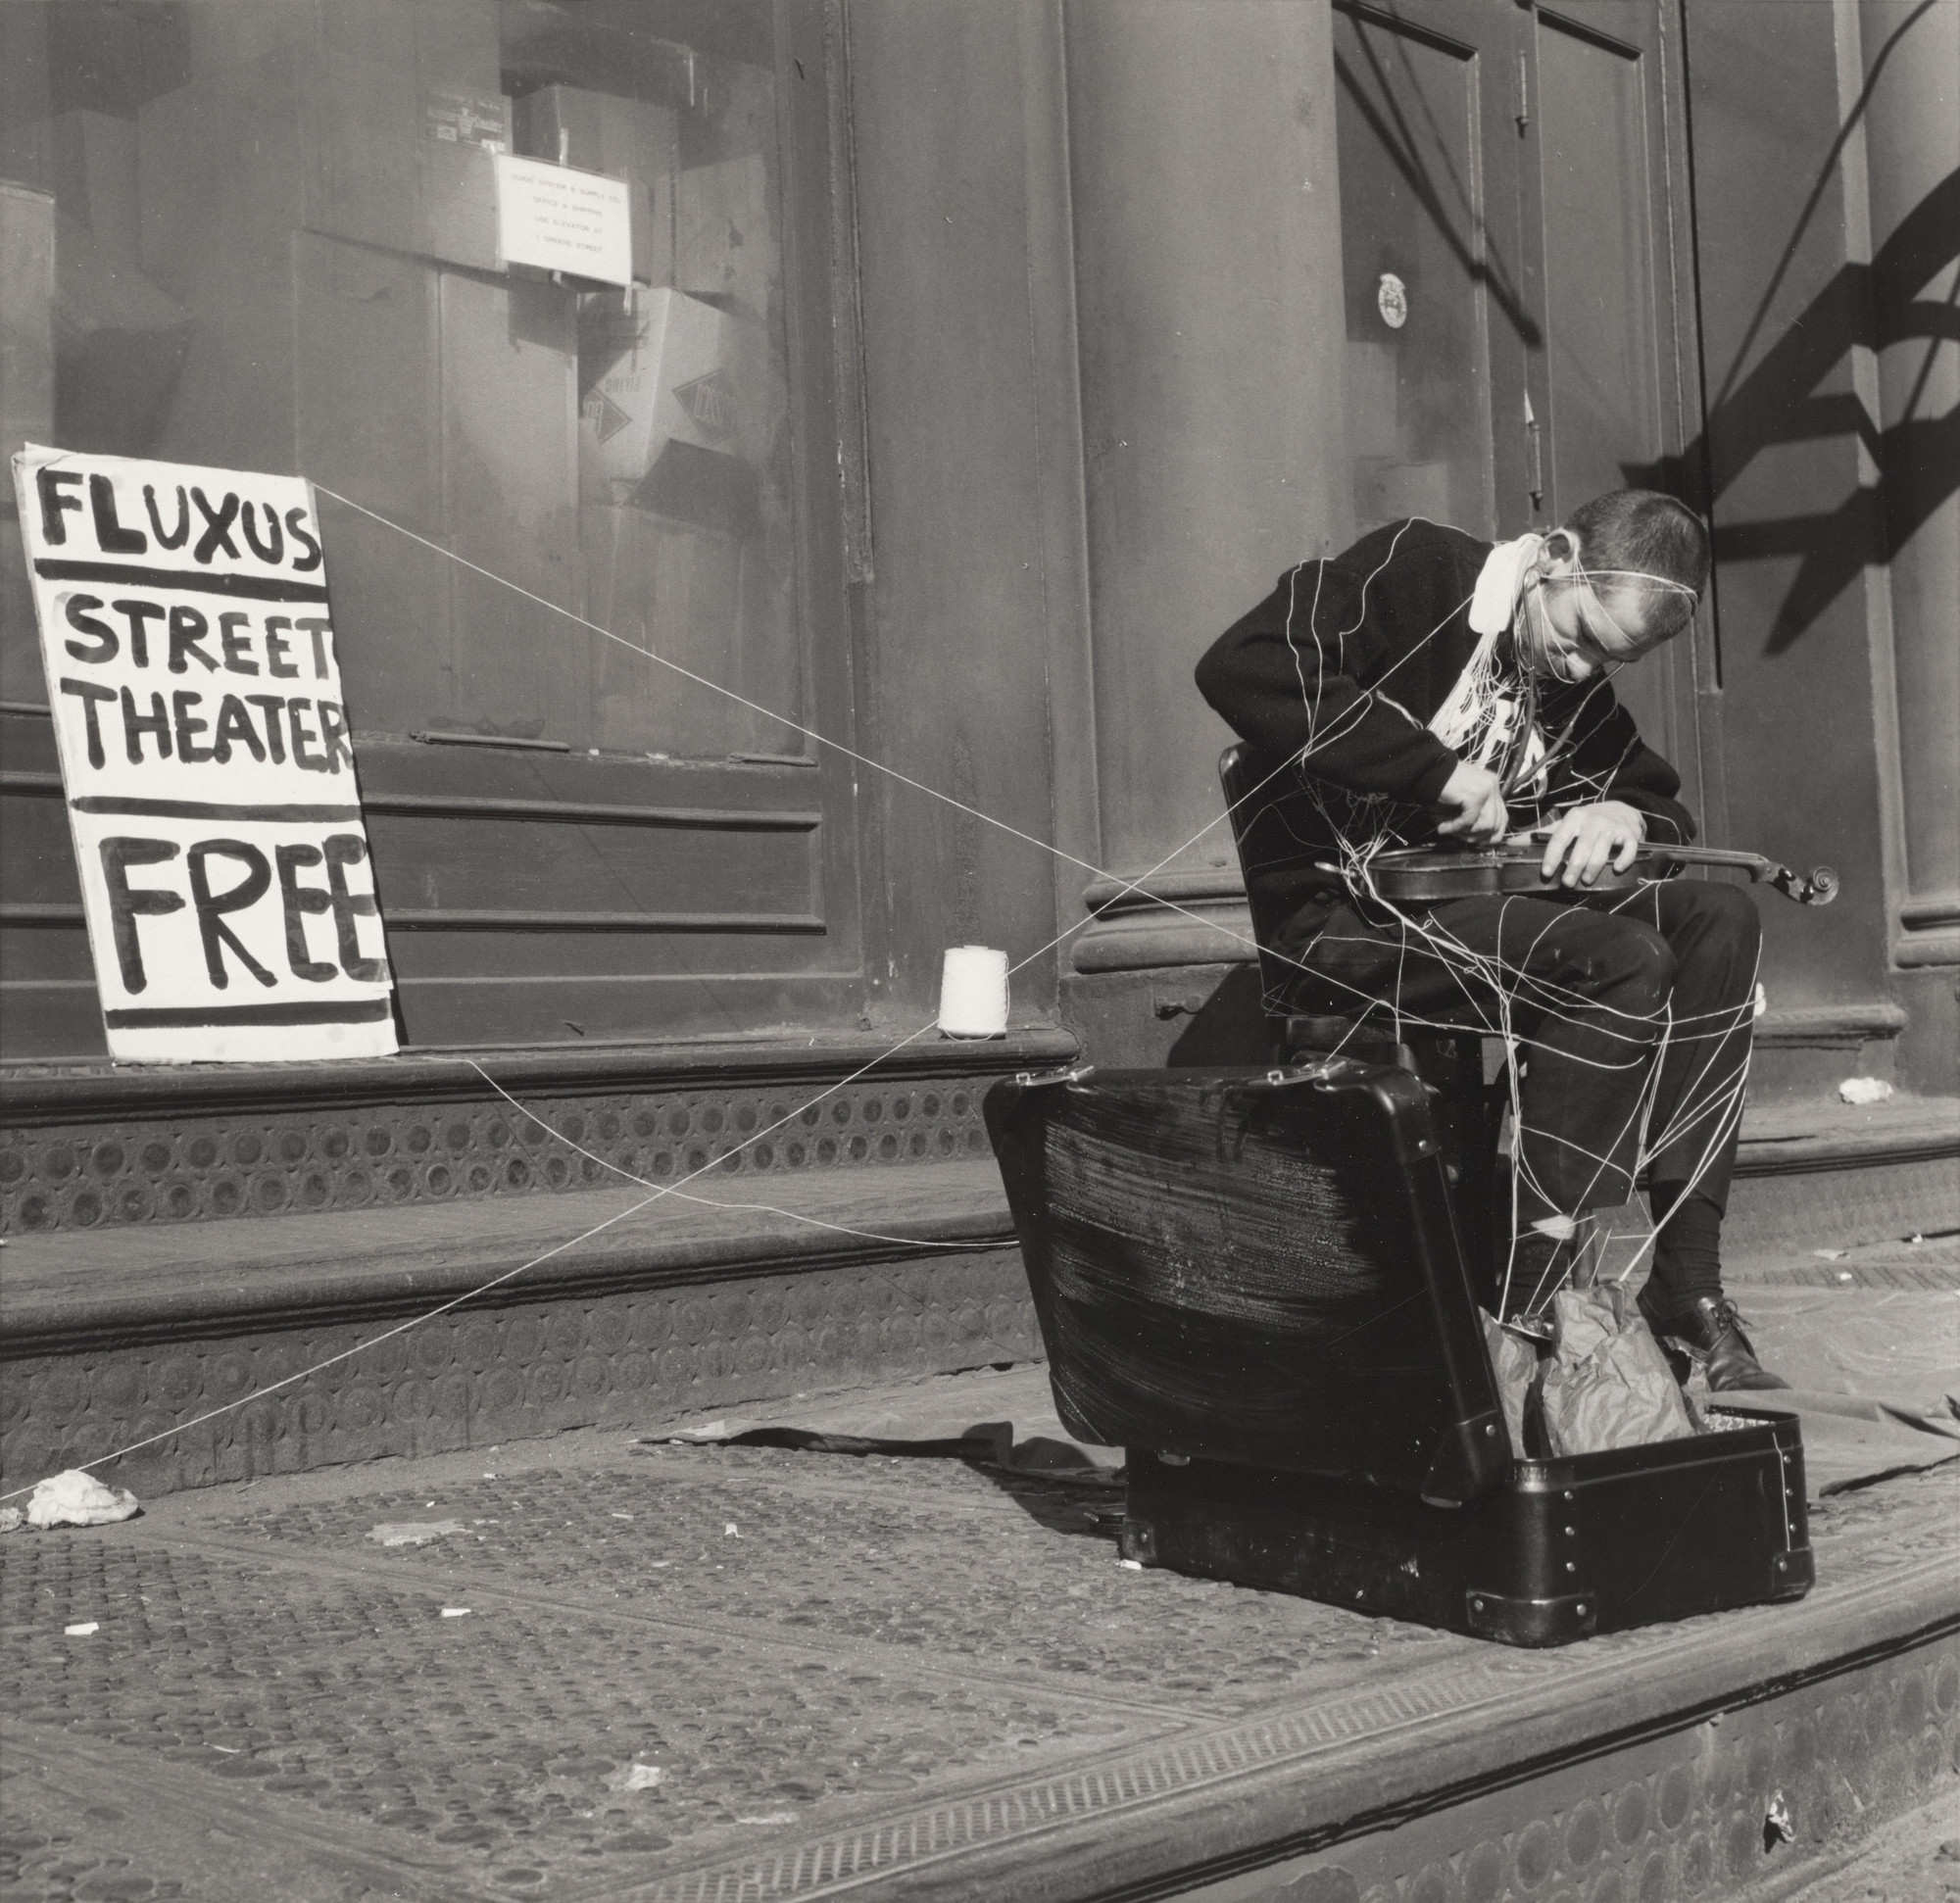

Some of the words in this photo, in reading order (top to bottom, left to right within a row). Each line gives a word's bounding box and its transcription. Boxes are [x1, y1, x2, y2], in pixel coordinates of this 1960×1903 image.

[553, 219, 590, 231] ELEVATOR
[576, 243, 603, 253] STREET
[35, 470, 321, 571] FLUXUS
[65, 593, 333, 680] STREET
[61, 677, 353, 774] THEATER
[99, 835, 388, 995] FREE
